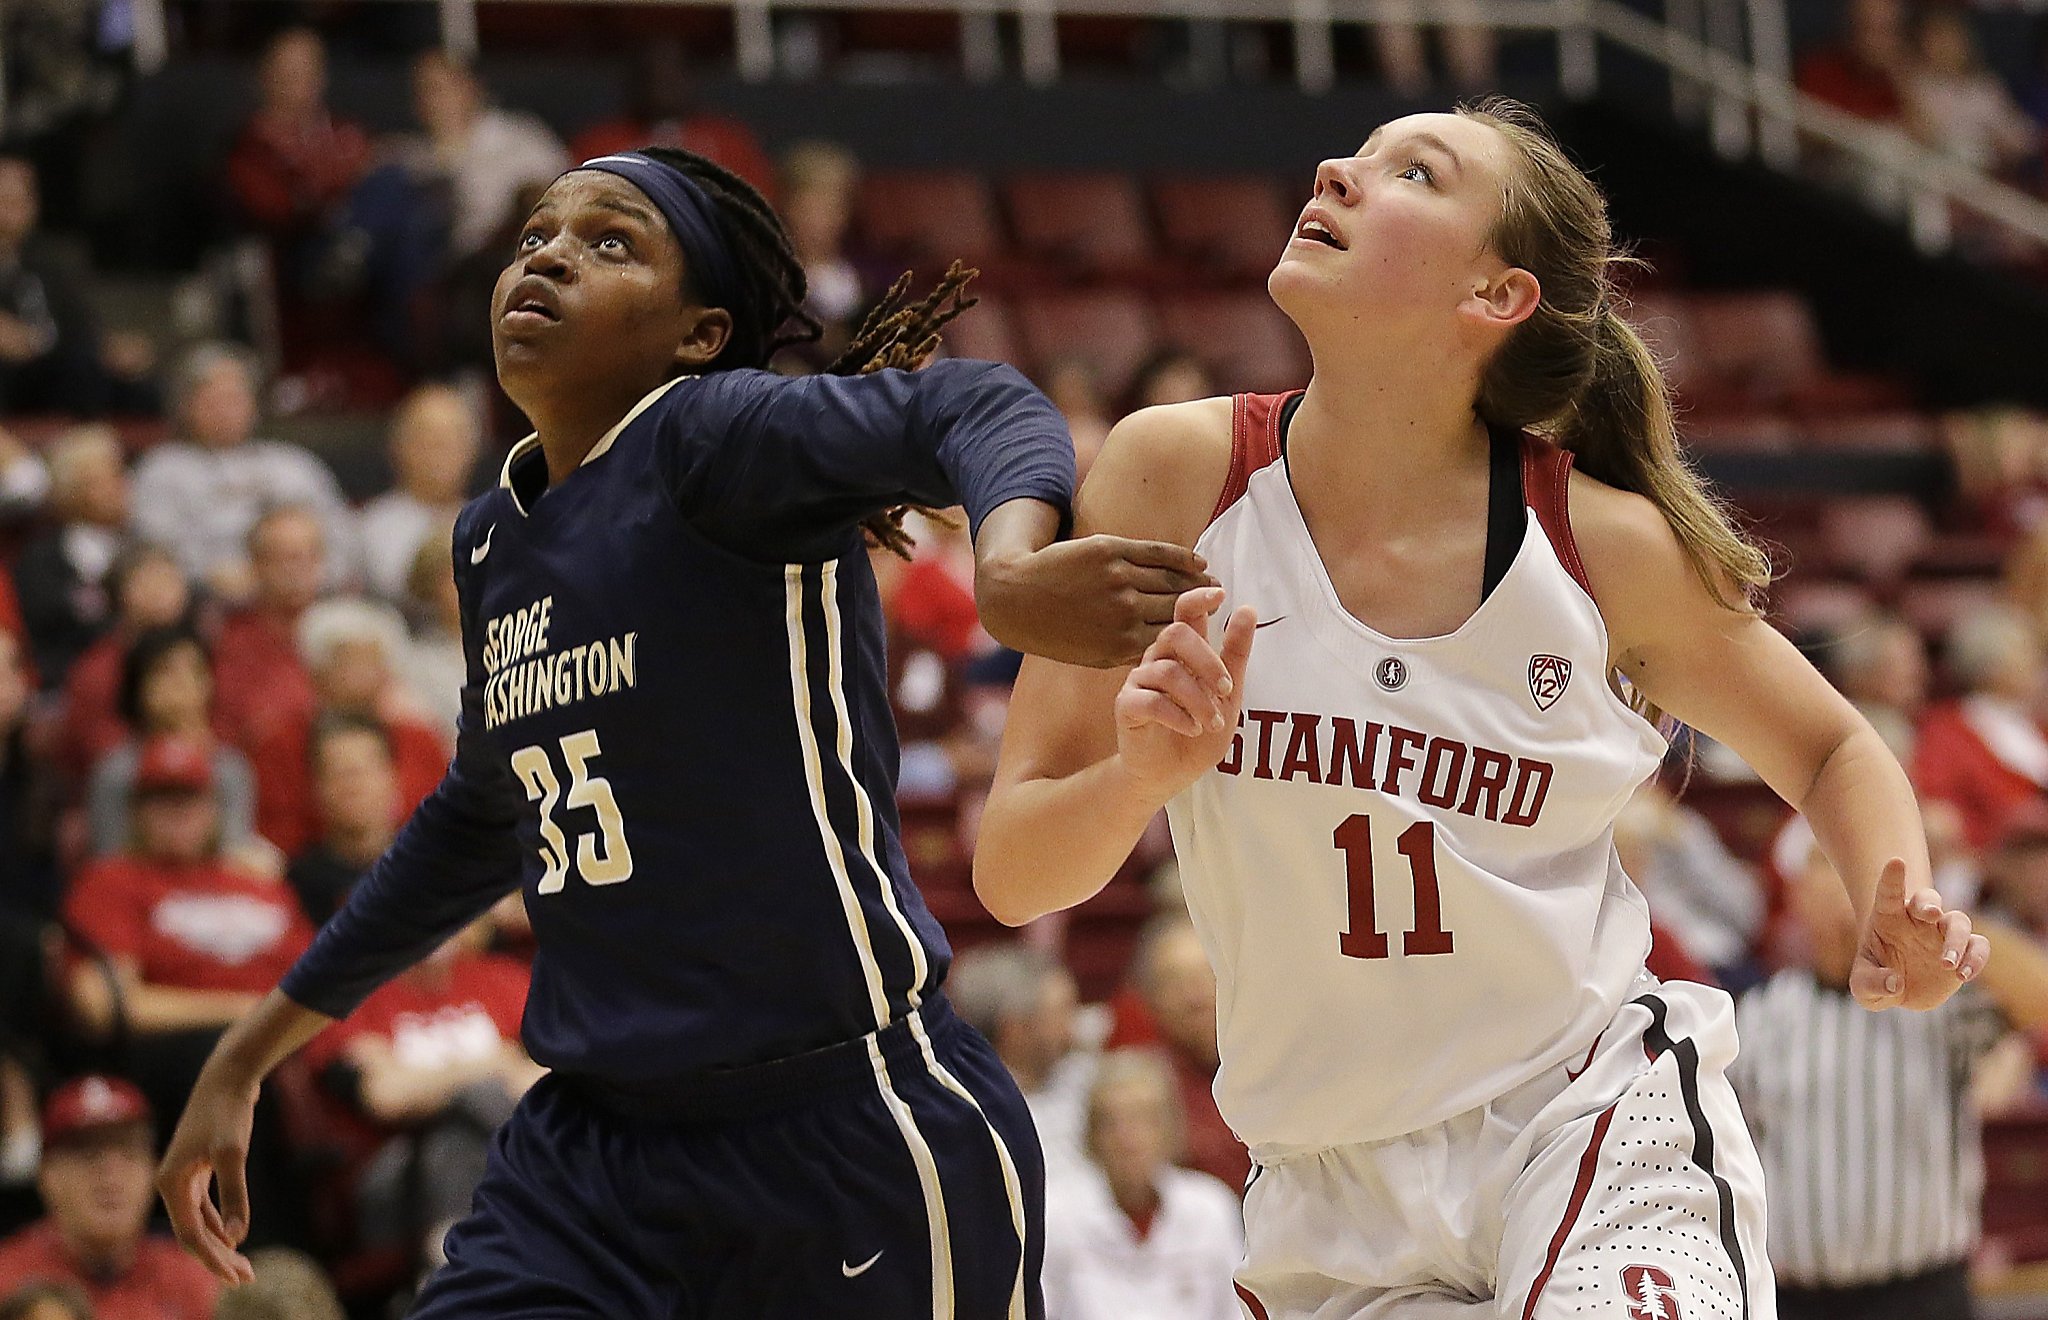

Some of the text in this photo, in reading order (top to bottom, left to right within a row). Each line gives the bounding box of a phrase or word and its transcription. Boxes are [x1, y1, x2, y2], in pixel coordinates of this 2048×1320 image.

[484, 631, 638, 732] ASHINGTON
[1531, 657, 1569, 690] PAC
[1535, 679, 1557, 699] 12
[511, 729, 633, 895] 35
[1215, 708, 1555, 828] STANFORD
[1332, 813, 1456, 960] 11
